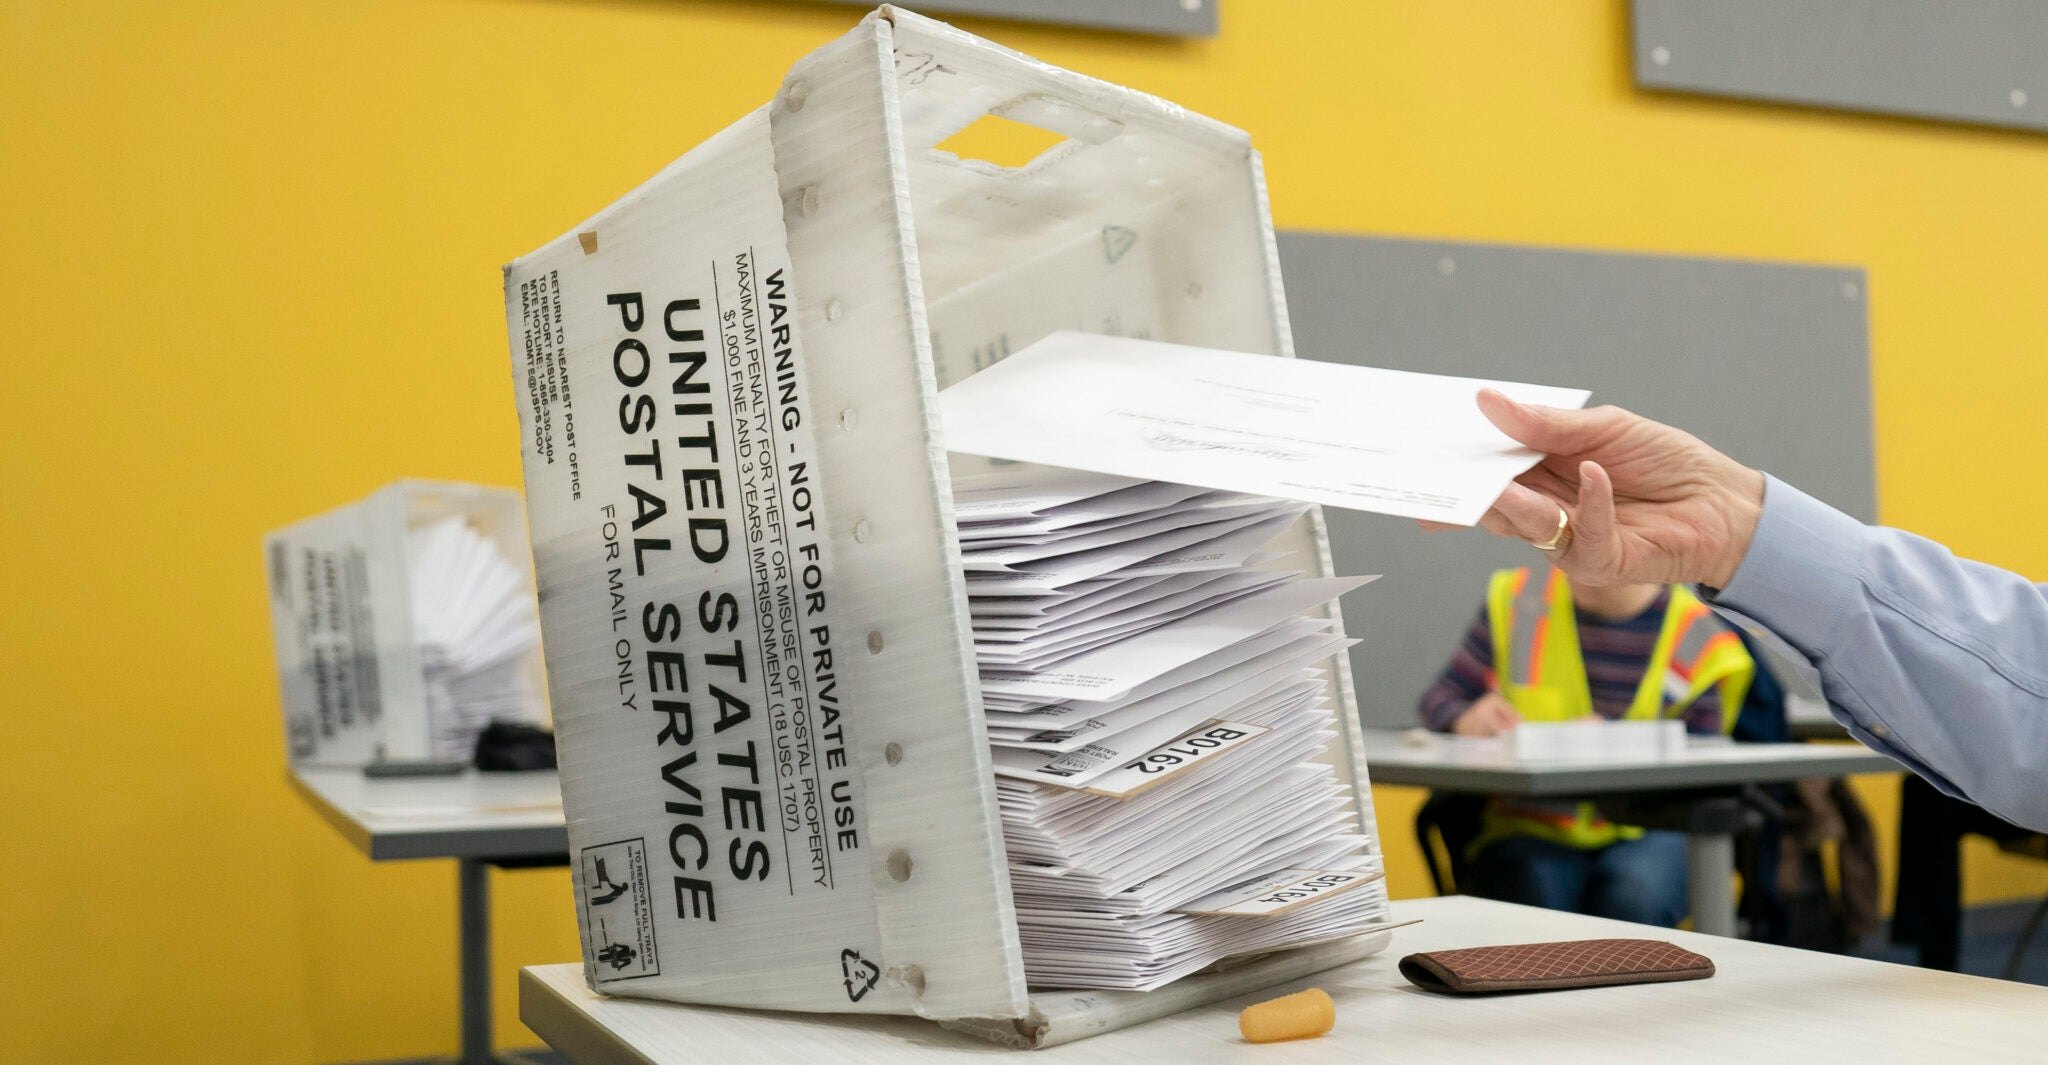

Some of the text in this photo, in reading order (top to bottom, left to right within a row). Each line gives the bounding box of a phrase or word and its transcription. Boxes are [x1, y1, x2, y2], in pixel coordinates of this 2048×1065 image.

[894, 48, 957, 85] 75
[521, 283, 544, 455] EMAIL: HQMTE@USPS.GOV
[530, 279, 555, 465] MTE HOTLINE: 1-866-330-3404
[539, 274, 558, 403] TO REPORT MISUSE
[550, 270, 581, 501] RETURN TO NEAREST POST OFFICE
[765, 268, 801, 432] WARNING
[788, 461, 815, 531] NOT
[600, 504, 638, 711] FOR MAIL ONLY
[606, 291, 717, 922] POSTAL SERVICE
[663, 298, 770, 882] UNITED STATES
[723, 309, 800, 832] $1,000 FINE AND 3 YEARS IMPRISONMENT (18 USC 1707)
[735, 253, 827, 887] MAXIMUM PENALTY FOR THEFT OR MISUSE OF POSTAL PROPERTY
[799, 543, 826, 617] FOR
[810, 625, 847, 770] PRIVATE
[1125, 728, 1248, 773] B0162
[830, 780, 858, 852] USE
[634, 849, 653, 965] TO REMOVE FULL TRAYS
[1258, 875, 1356, 903] B0164
[854, 970, 866, 981] 2
